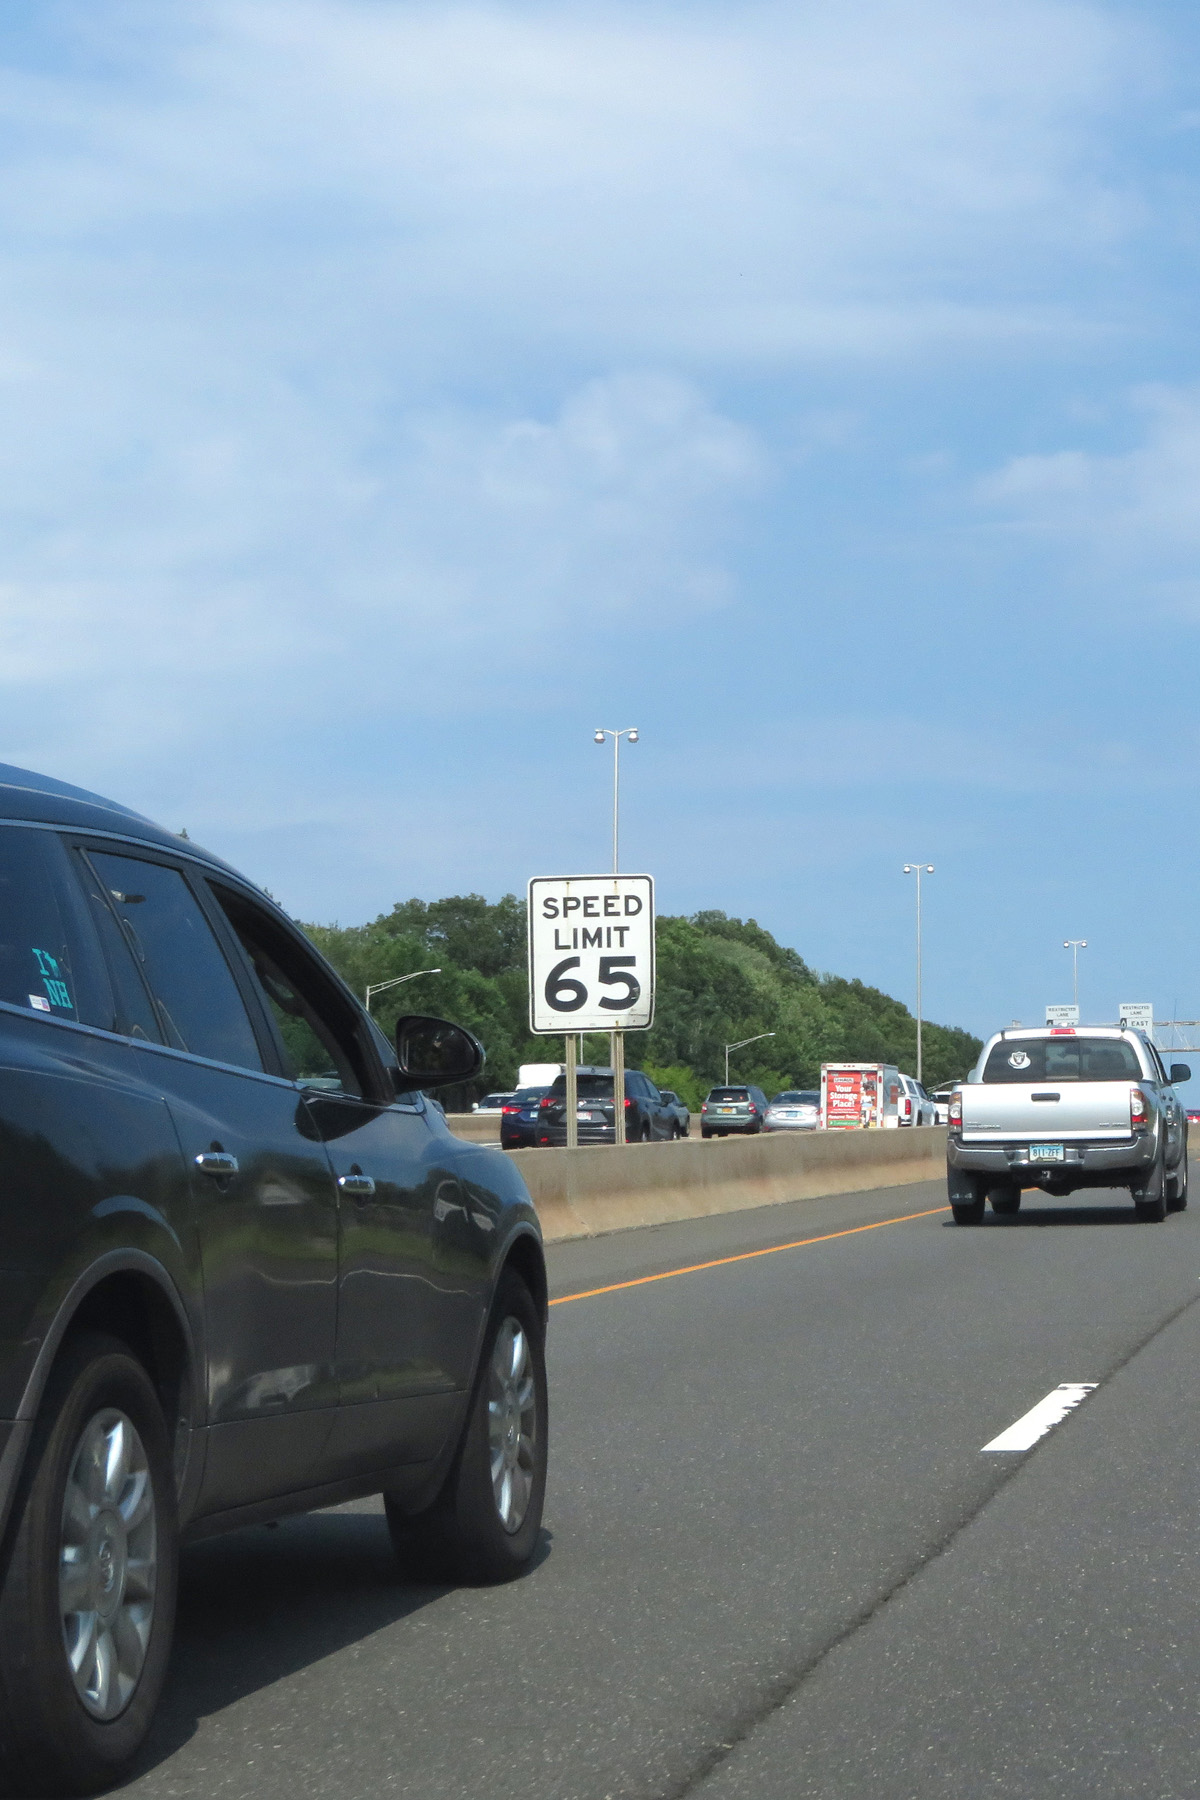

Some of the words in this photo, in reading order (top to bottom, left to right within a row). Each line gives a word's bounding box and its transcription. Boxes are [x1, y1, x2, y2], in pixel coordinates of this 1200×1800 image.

[542, 895, 643, 919] SPEED
[554, 926, 630, 950] LIMIT
[42, 977, 74, 1009] NH
[544, 956, 641, 1013] 65
[830, 1092, 858, 1101] Storage
